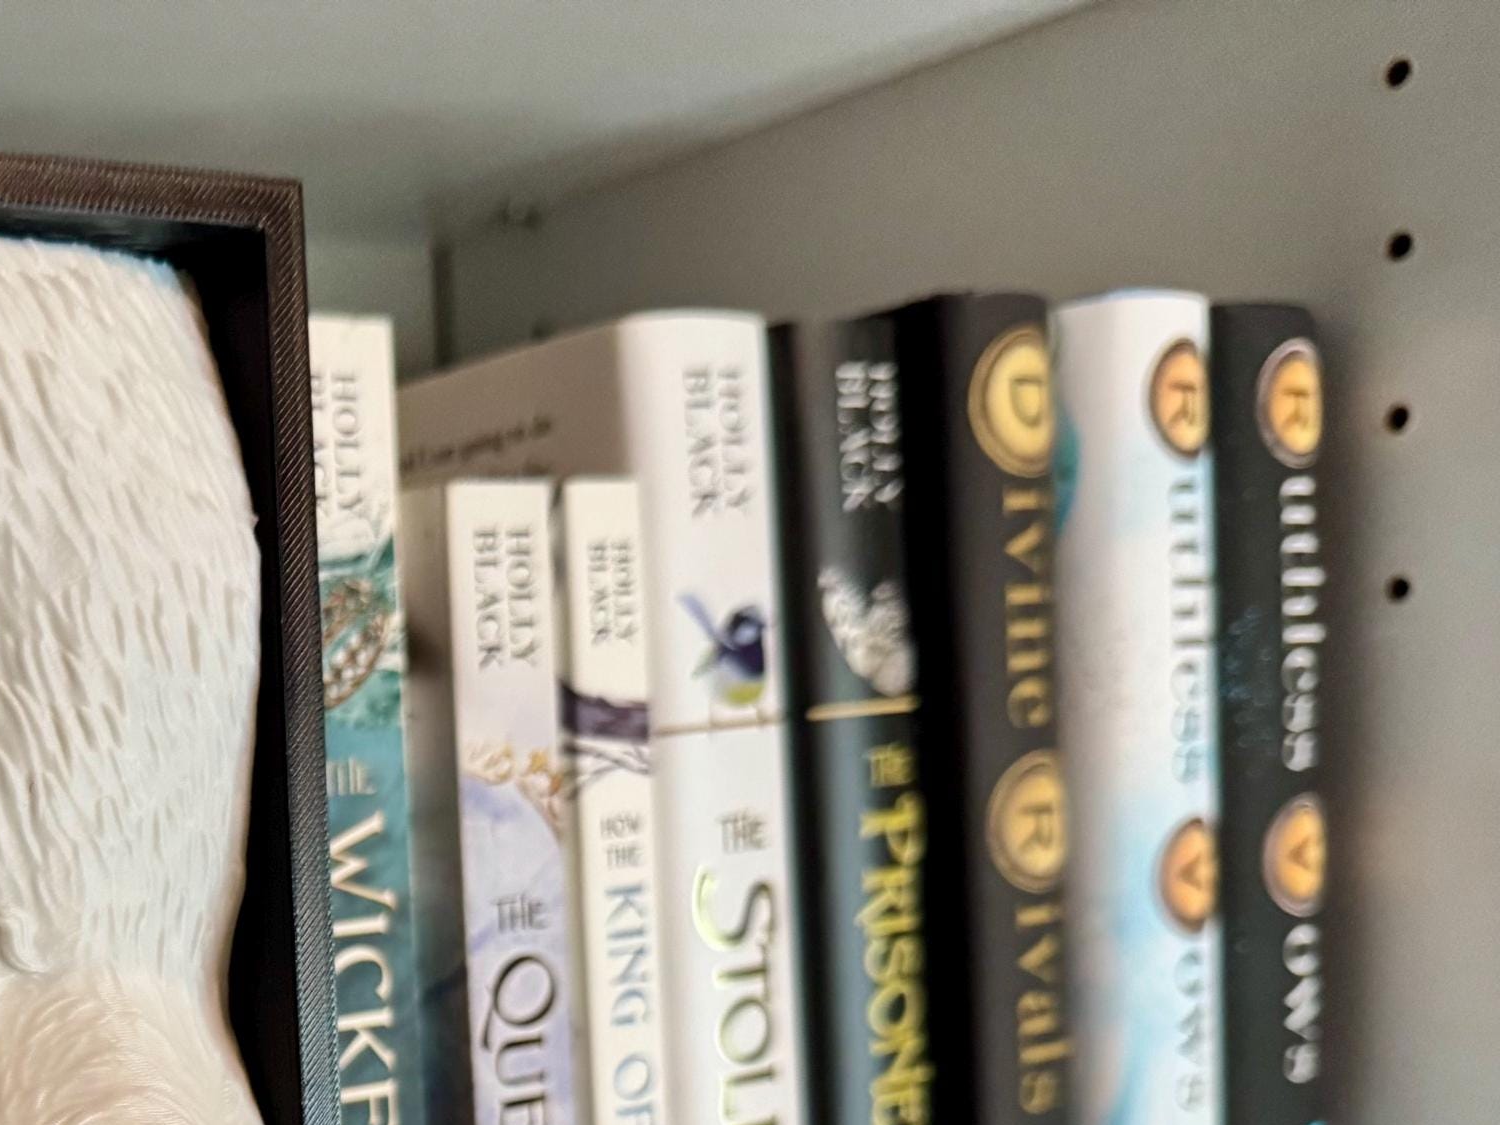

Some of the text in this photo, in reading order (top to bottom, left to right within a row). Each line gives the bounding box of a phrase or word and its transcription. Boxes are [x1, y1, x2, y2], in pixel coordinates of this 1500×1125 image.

[472, 525, 503, 669] BLACK
[506, 523, 547, 667] HOLLY
[604, 882, 652, 1027] KING
